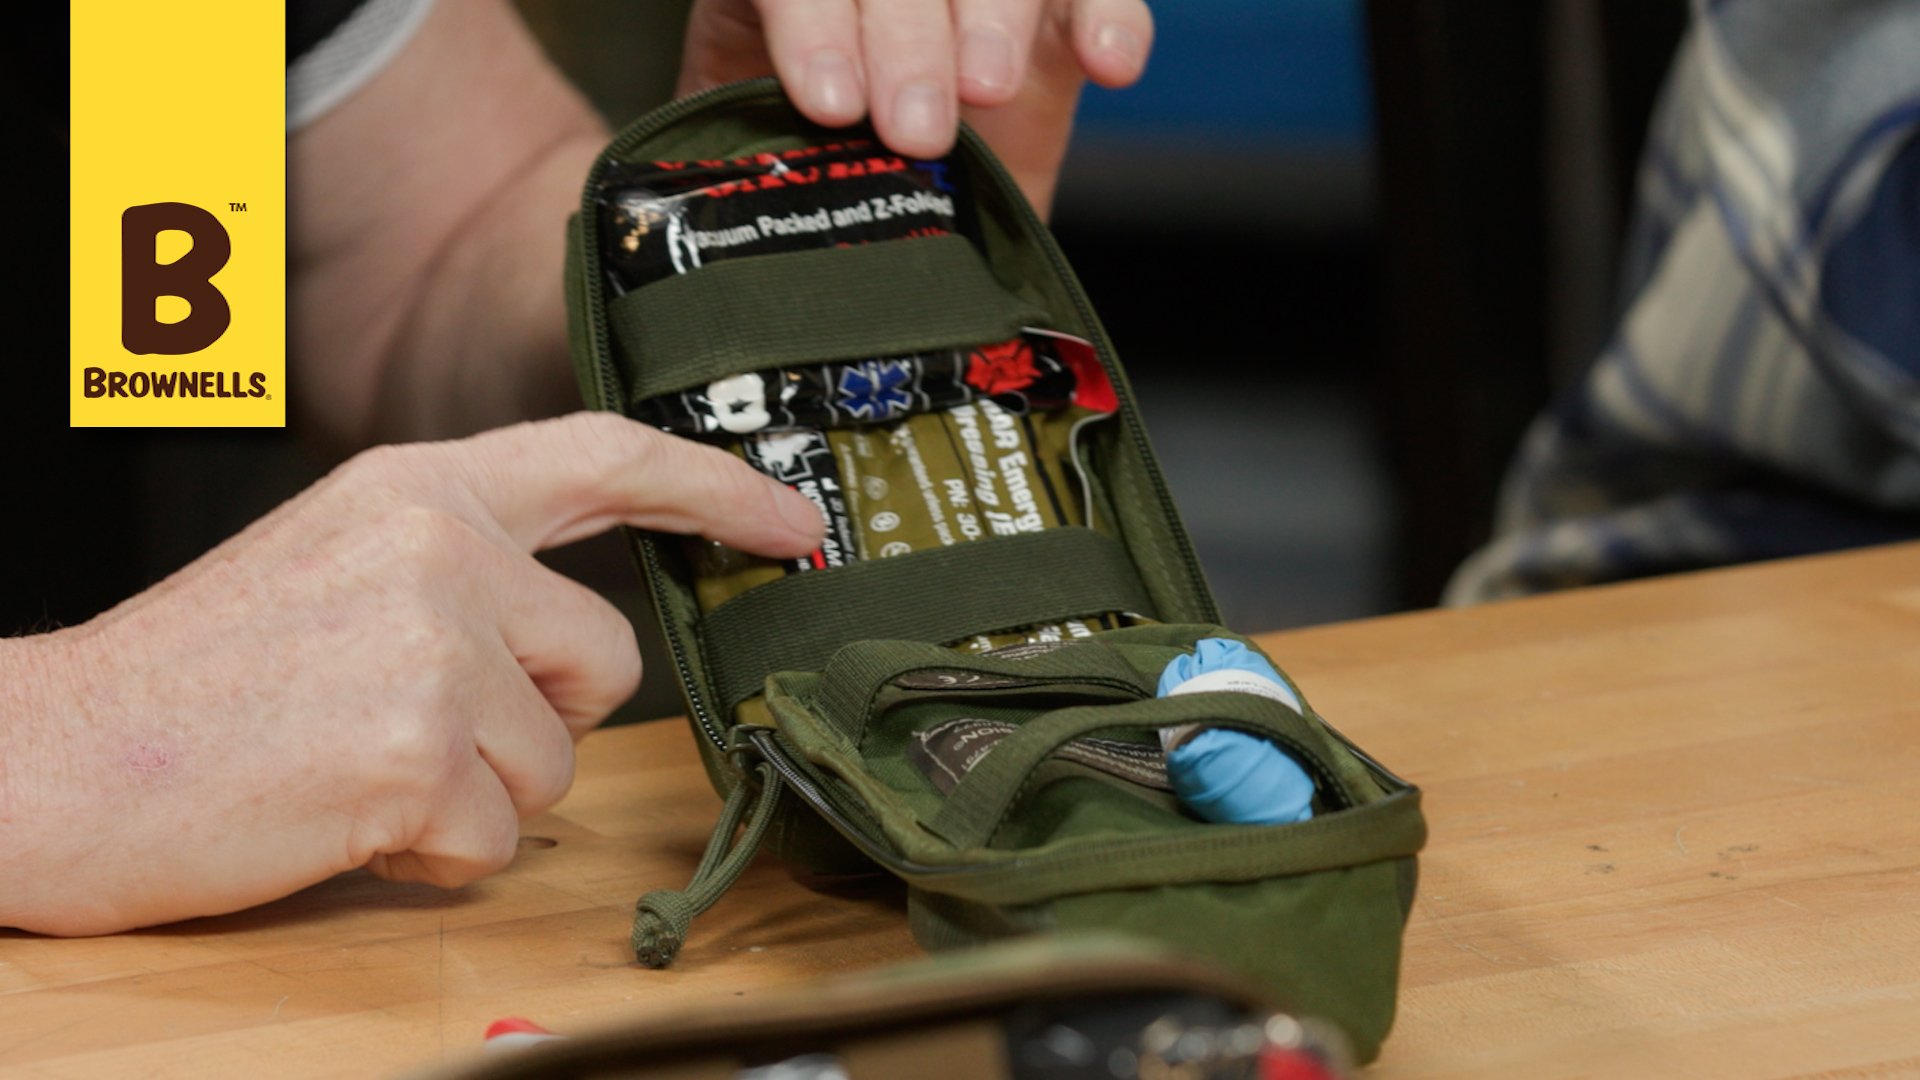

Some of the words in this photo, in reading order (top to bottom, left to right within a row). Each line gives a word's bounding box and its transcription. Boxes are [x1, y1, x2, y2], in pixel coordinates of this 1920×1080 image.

[757, 206, 832, 236] Packed
[831, 201, 871, 228] and
[998, 451, 1044, 532] Emerg
[822, 538, 844, 567] AM
